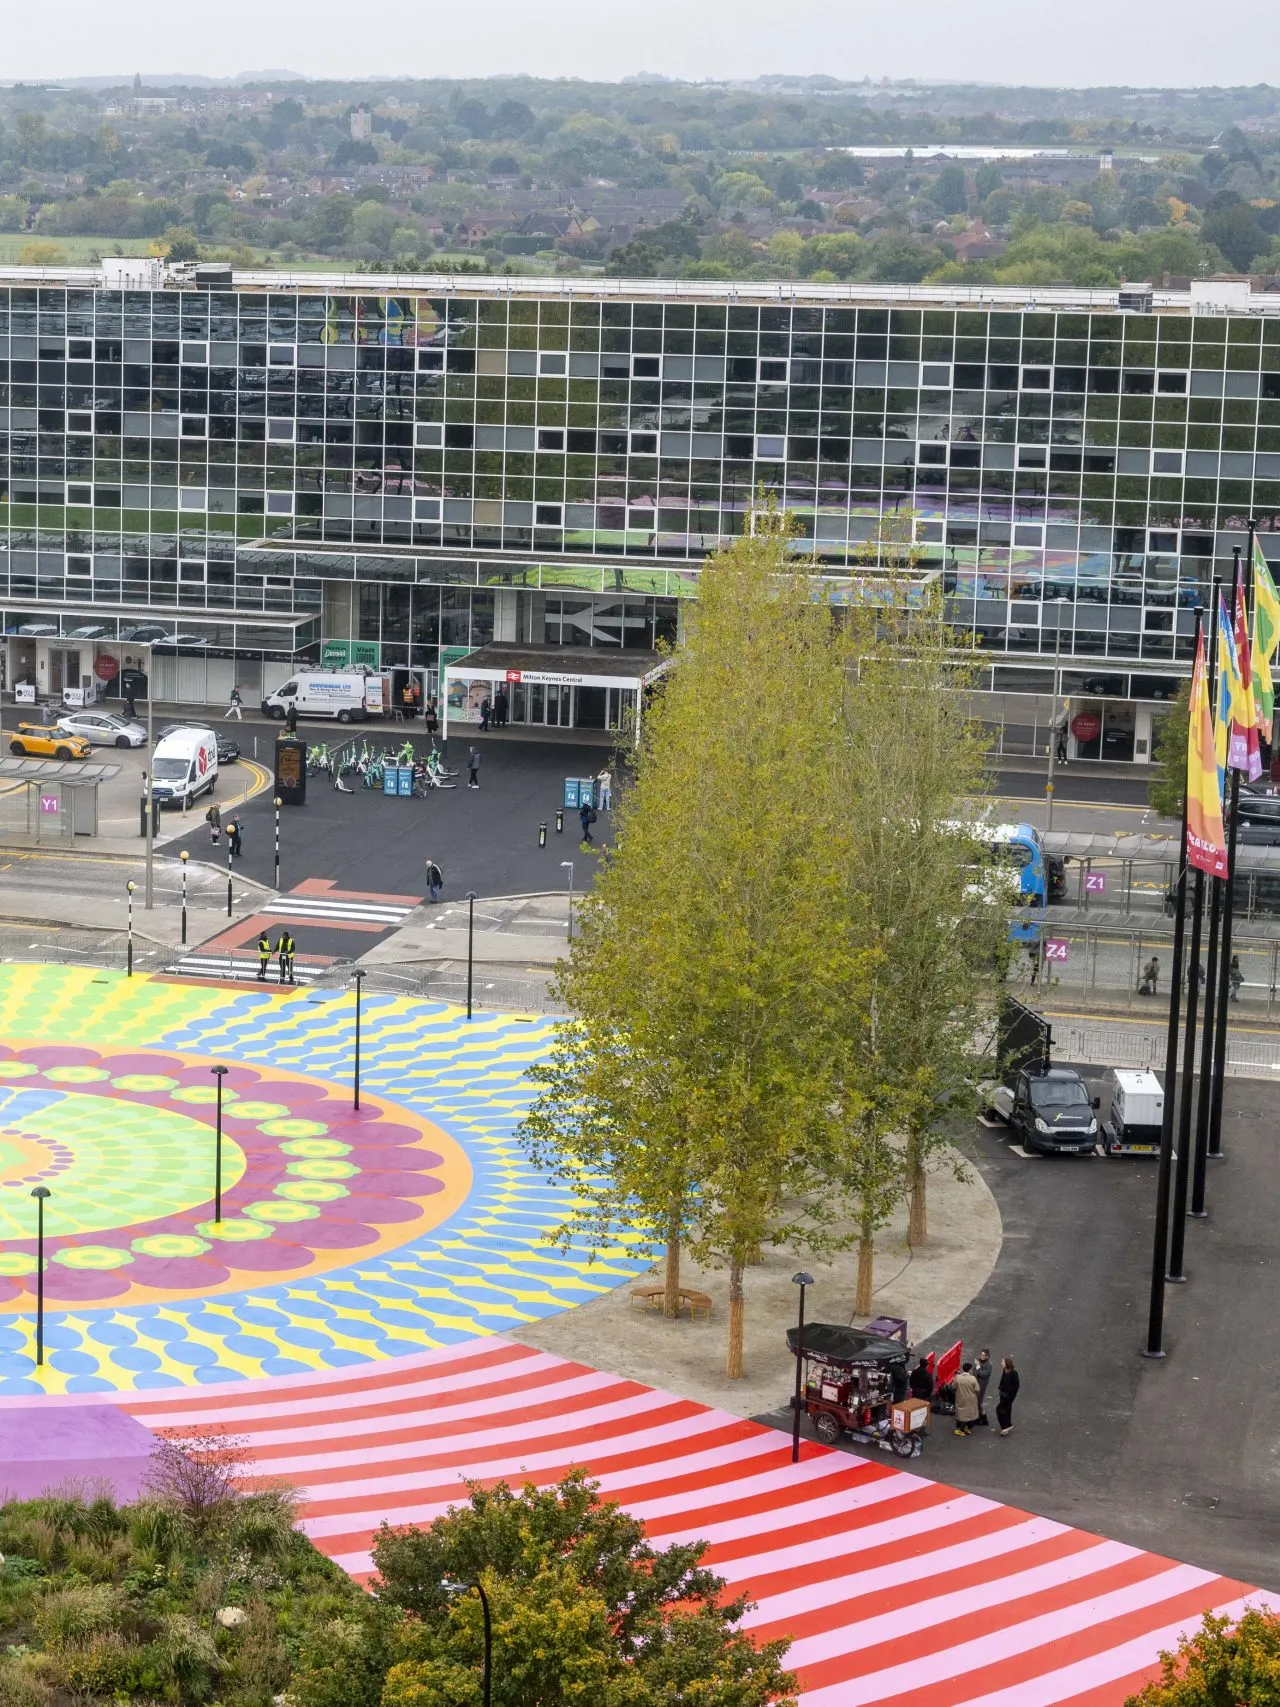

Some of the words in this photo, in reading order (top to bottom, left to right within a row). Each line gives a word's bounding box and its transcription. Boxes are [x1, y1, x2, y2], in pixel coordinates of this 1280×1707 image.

[42, 799, 56, 810] Y1
[1086, 876, 1104, 889] Z1
[1046, 944, 1067, 958] Z4
